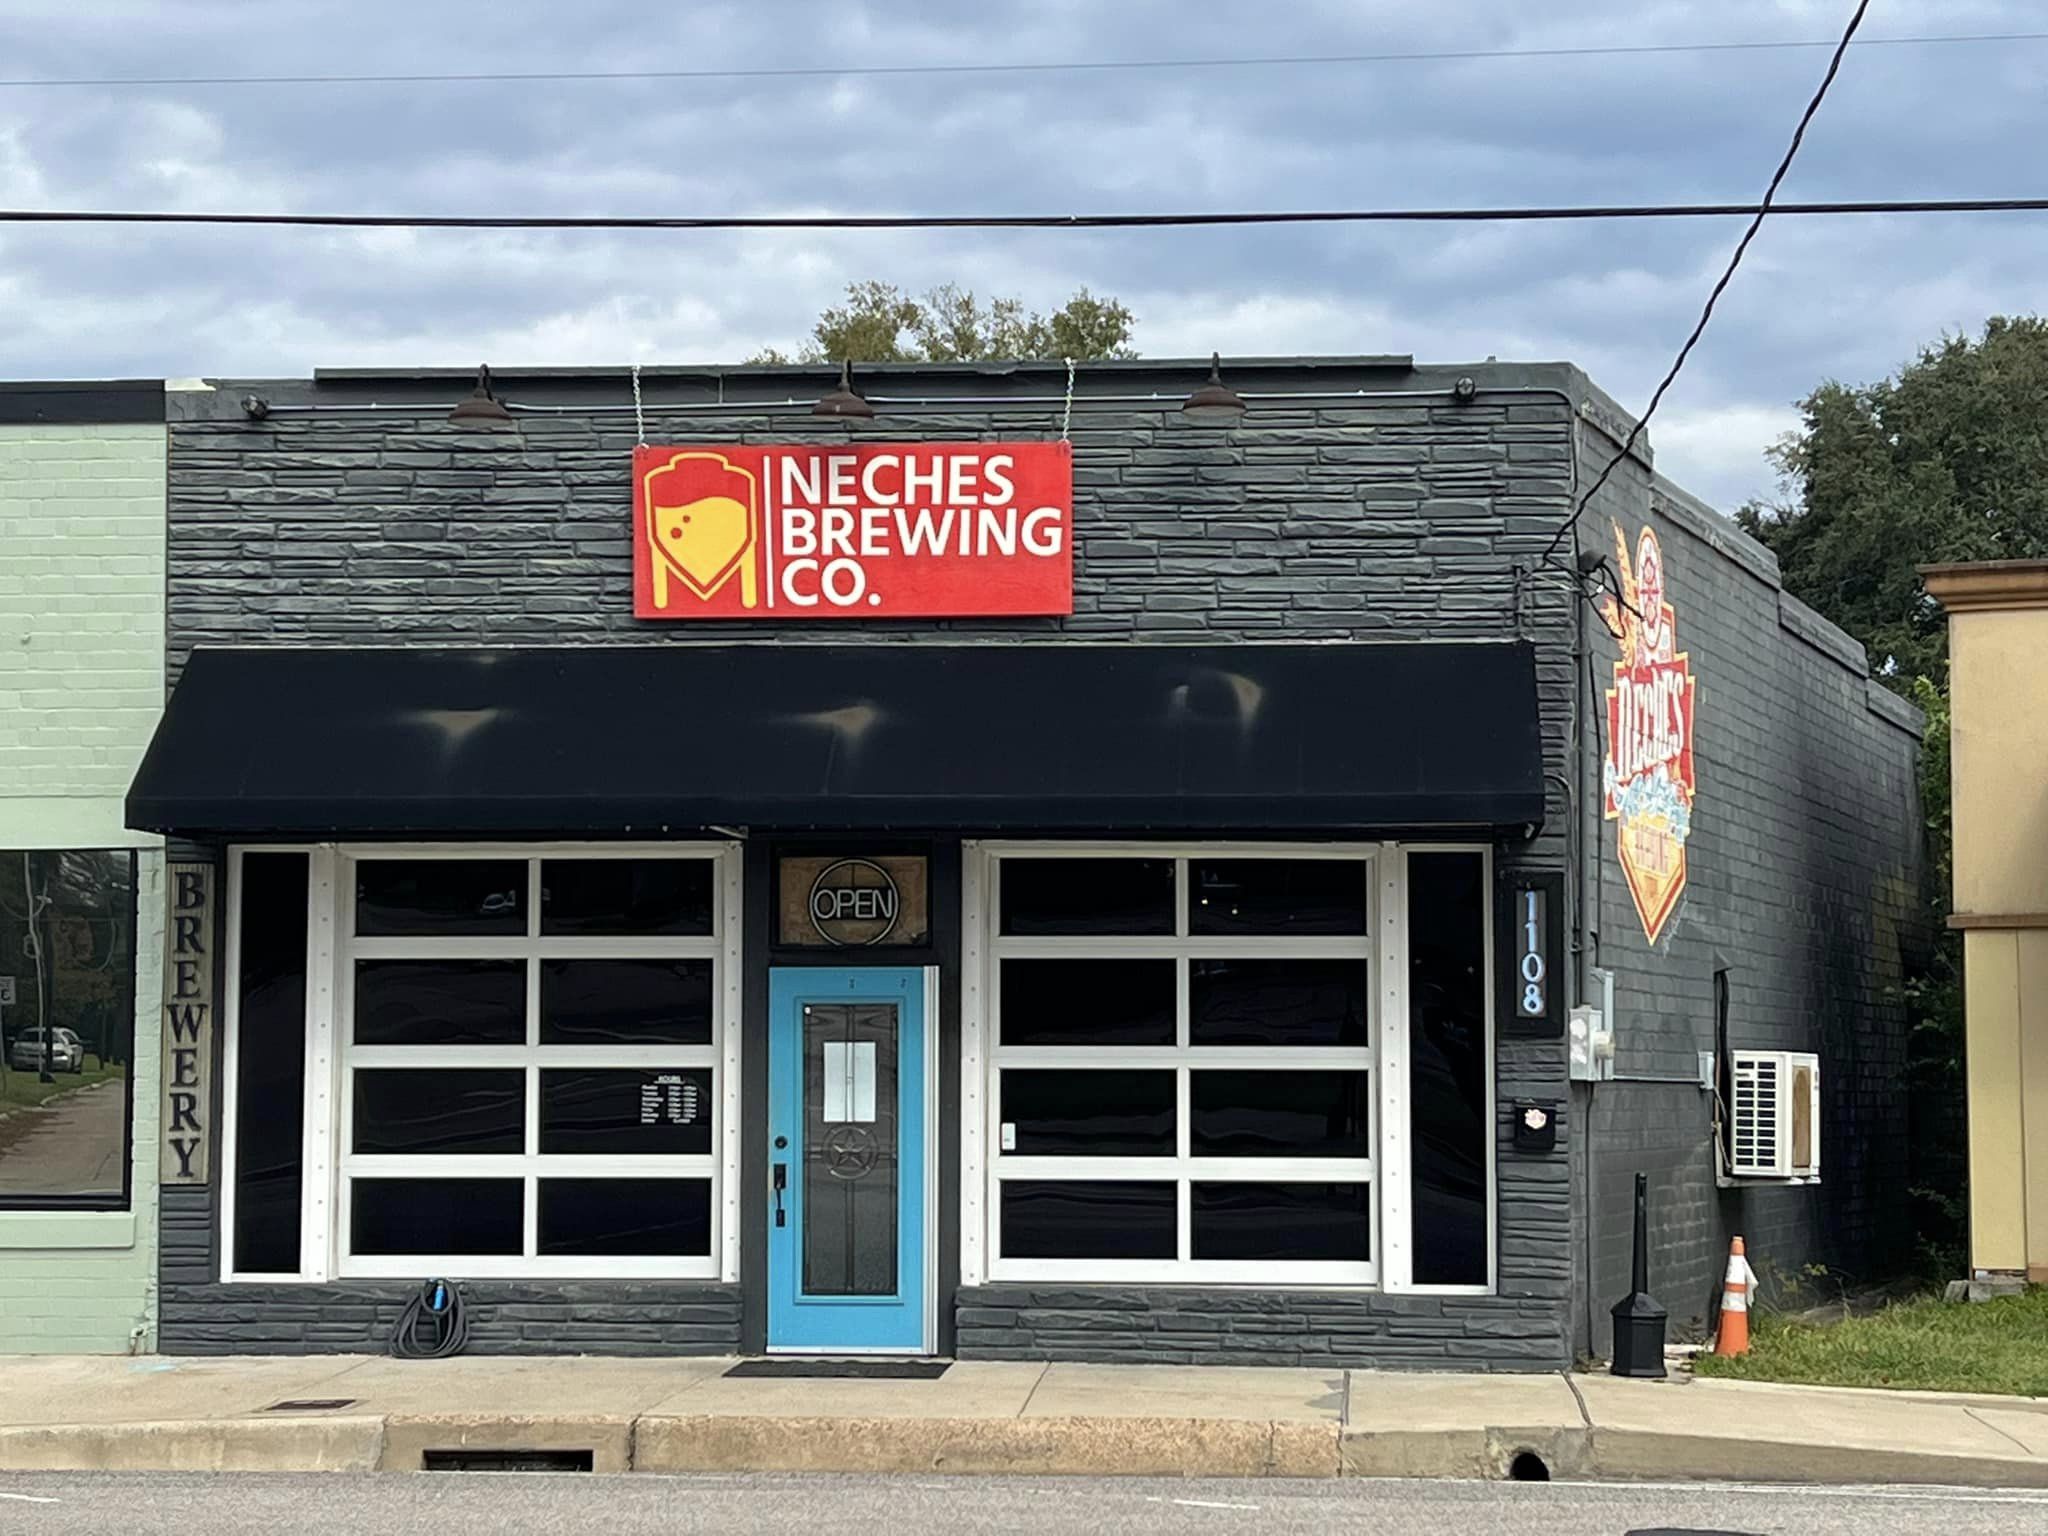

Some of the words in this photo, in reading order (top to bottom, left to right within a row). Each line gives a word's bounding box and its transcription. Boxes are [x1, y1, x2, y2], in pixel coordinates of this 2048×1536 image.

[781, 454, 1014, 505] NECHES
[781, 507, 1063, 557] BREWING
[781, 558, 881, 606] CO.
[814, 889, 893, 919] OPEN
[1521, 890, 1545, 1014] 1108
[166, 871, 208, 1178] BREWERY
